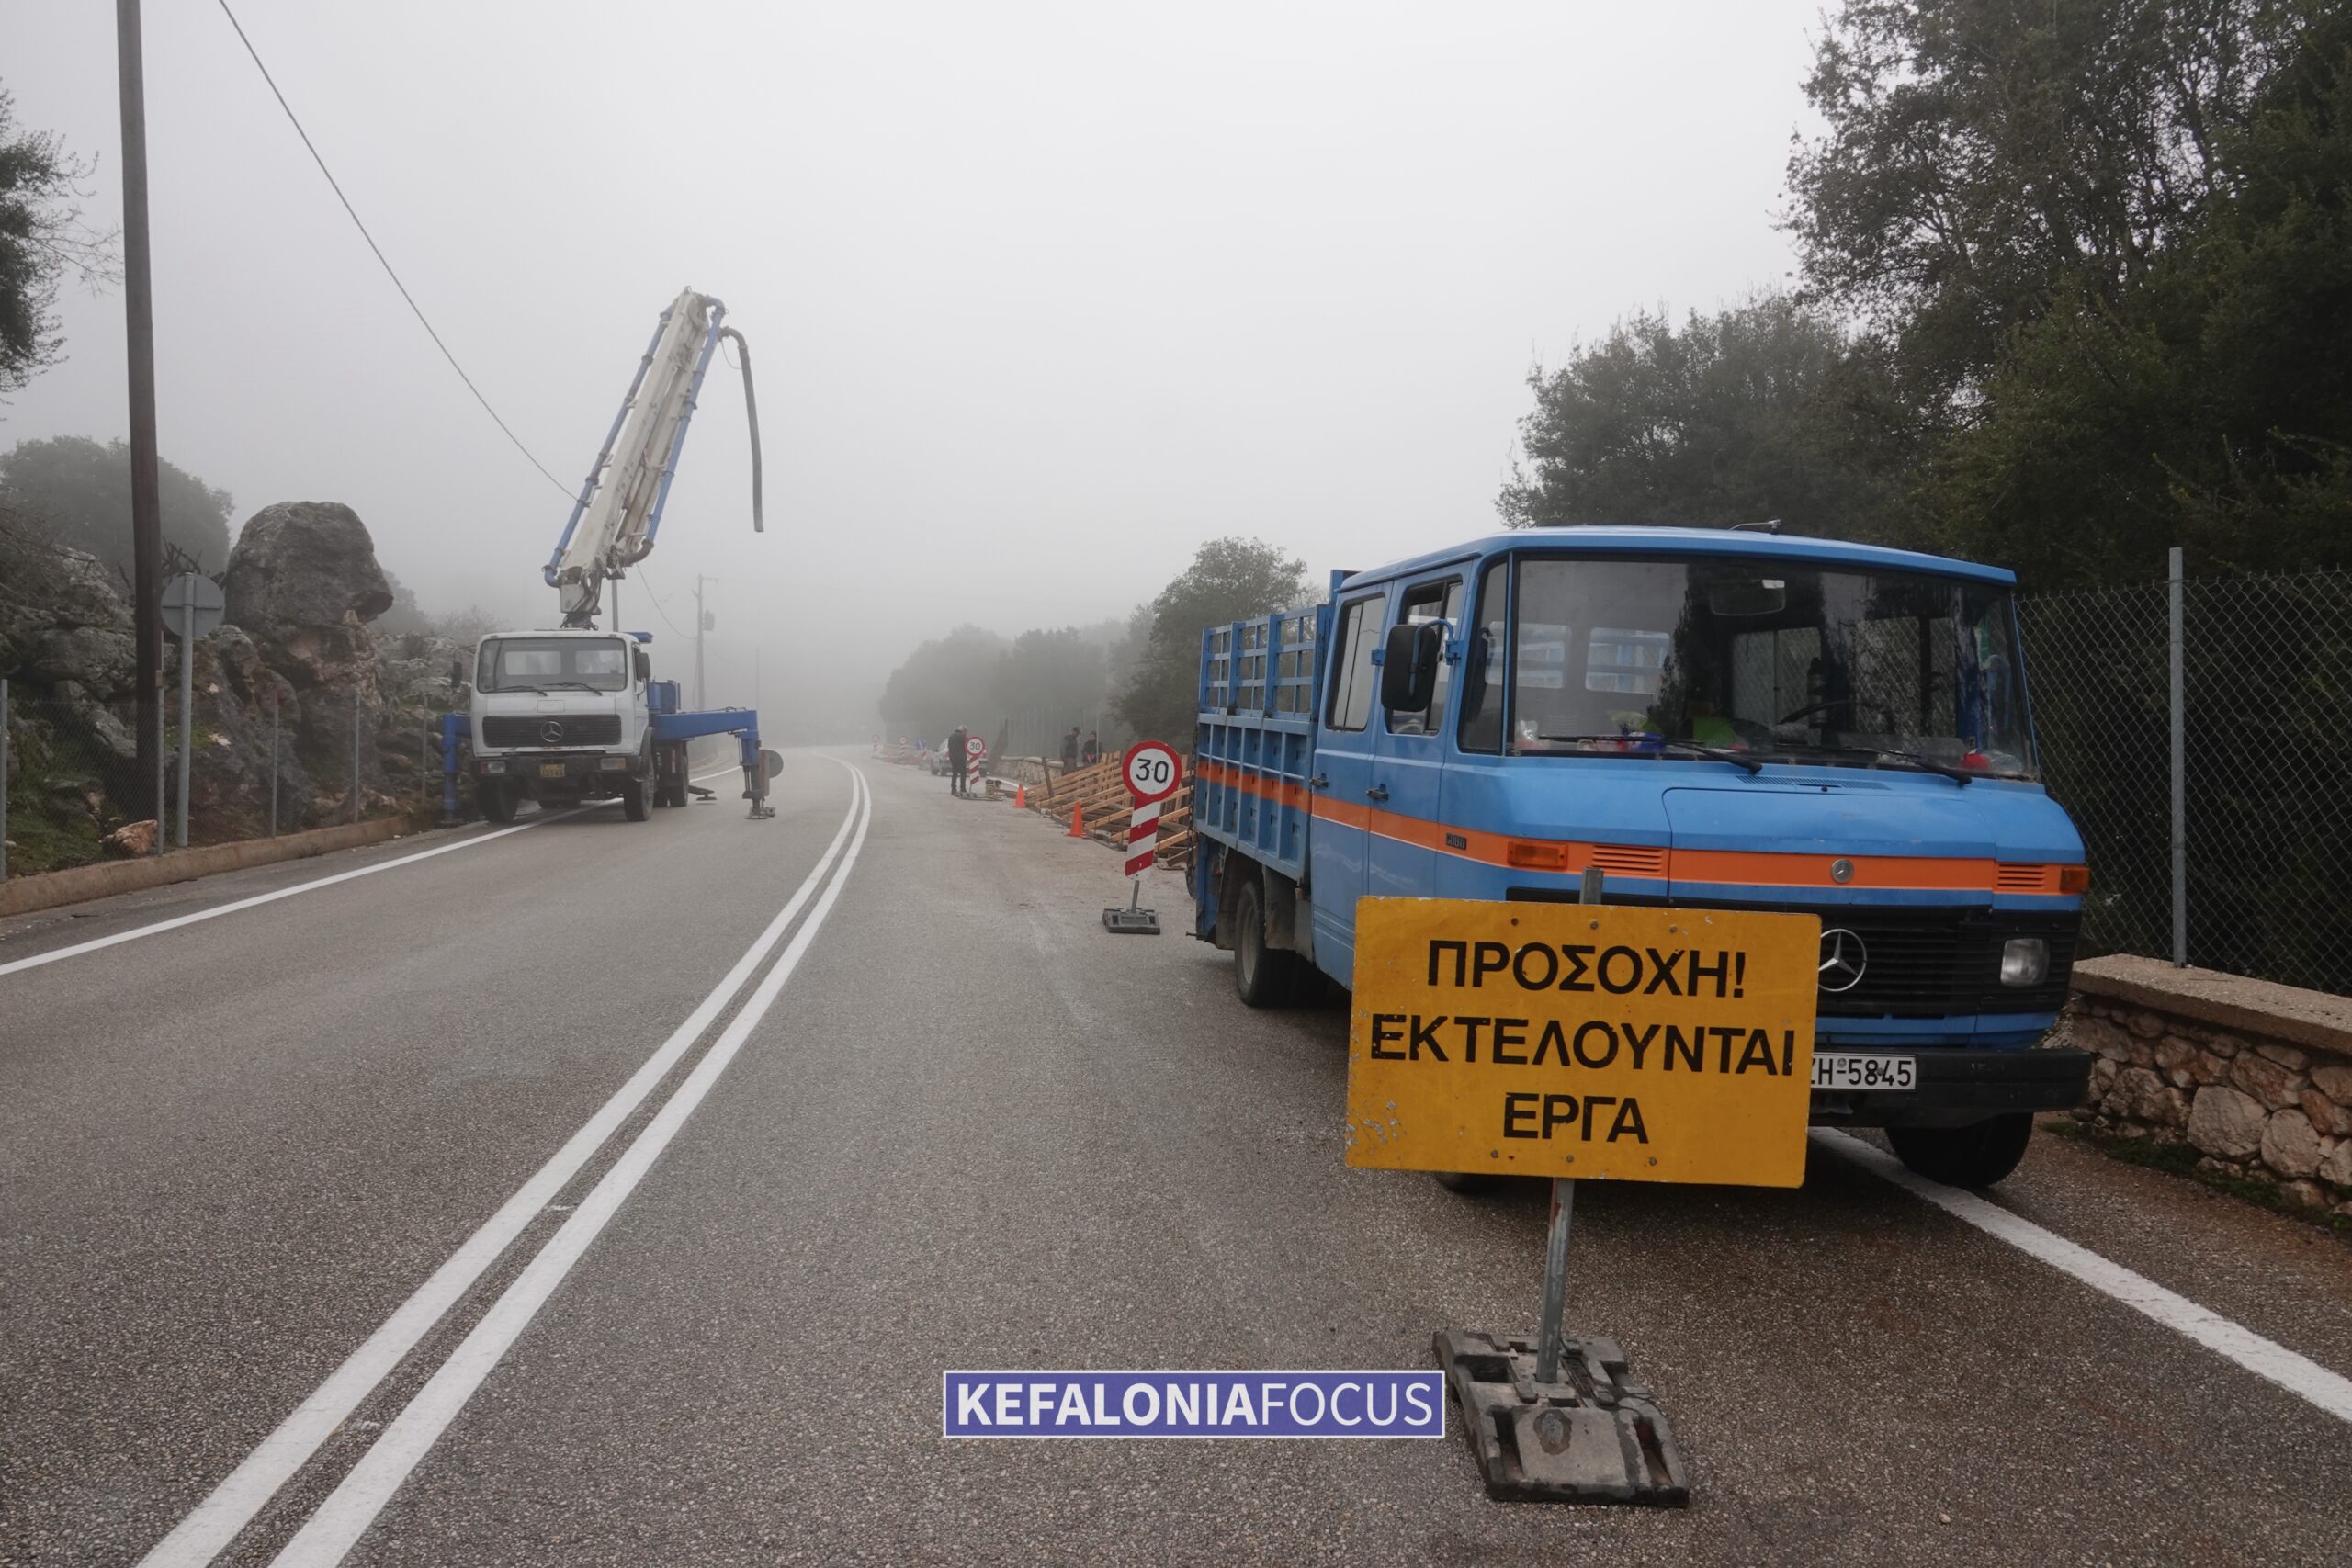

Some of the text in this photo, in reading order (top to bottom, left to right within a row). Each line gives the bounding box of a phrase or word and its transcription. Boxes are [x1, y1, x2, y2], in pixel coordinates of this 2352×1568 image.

[969, 741, 981, 750] 30
[1136, 758, 1169, 784] 30
[1428, 939, 1746, 998] ΠΡΟΣΟΧΗ!
[1371, 1013, 1795, 1077] ΕΚΤΕΛΟΥΝΤΑΙ
[1503, 1092, 1649, 1145] ΕΡΓΑ
